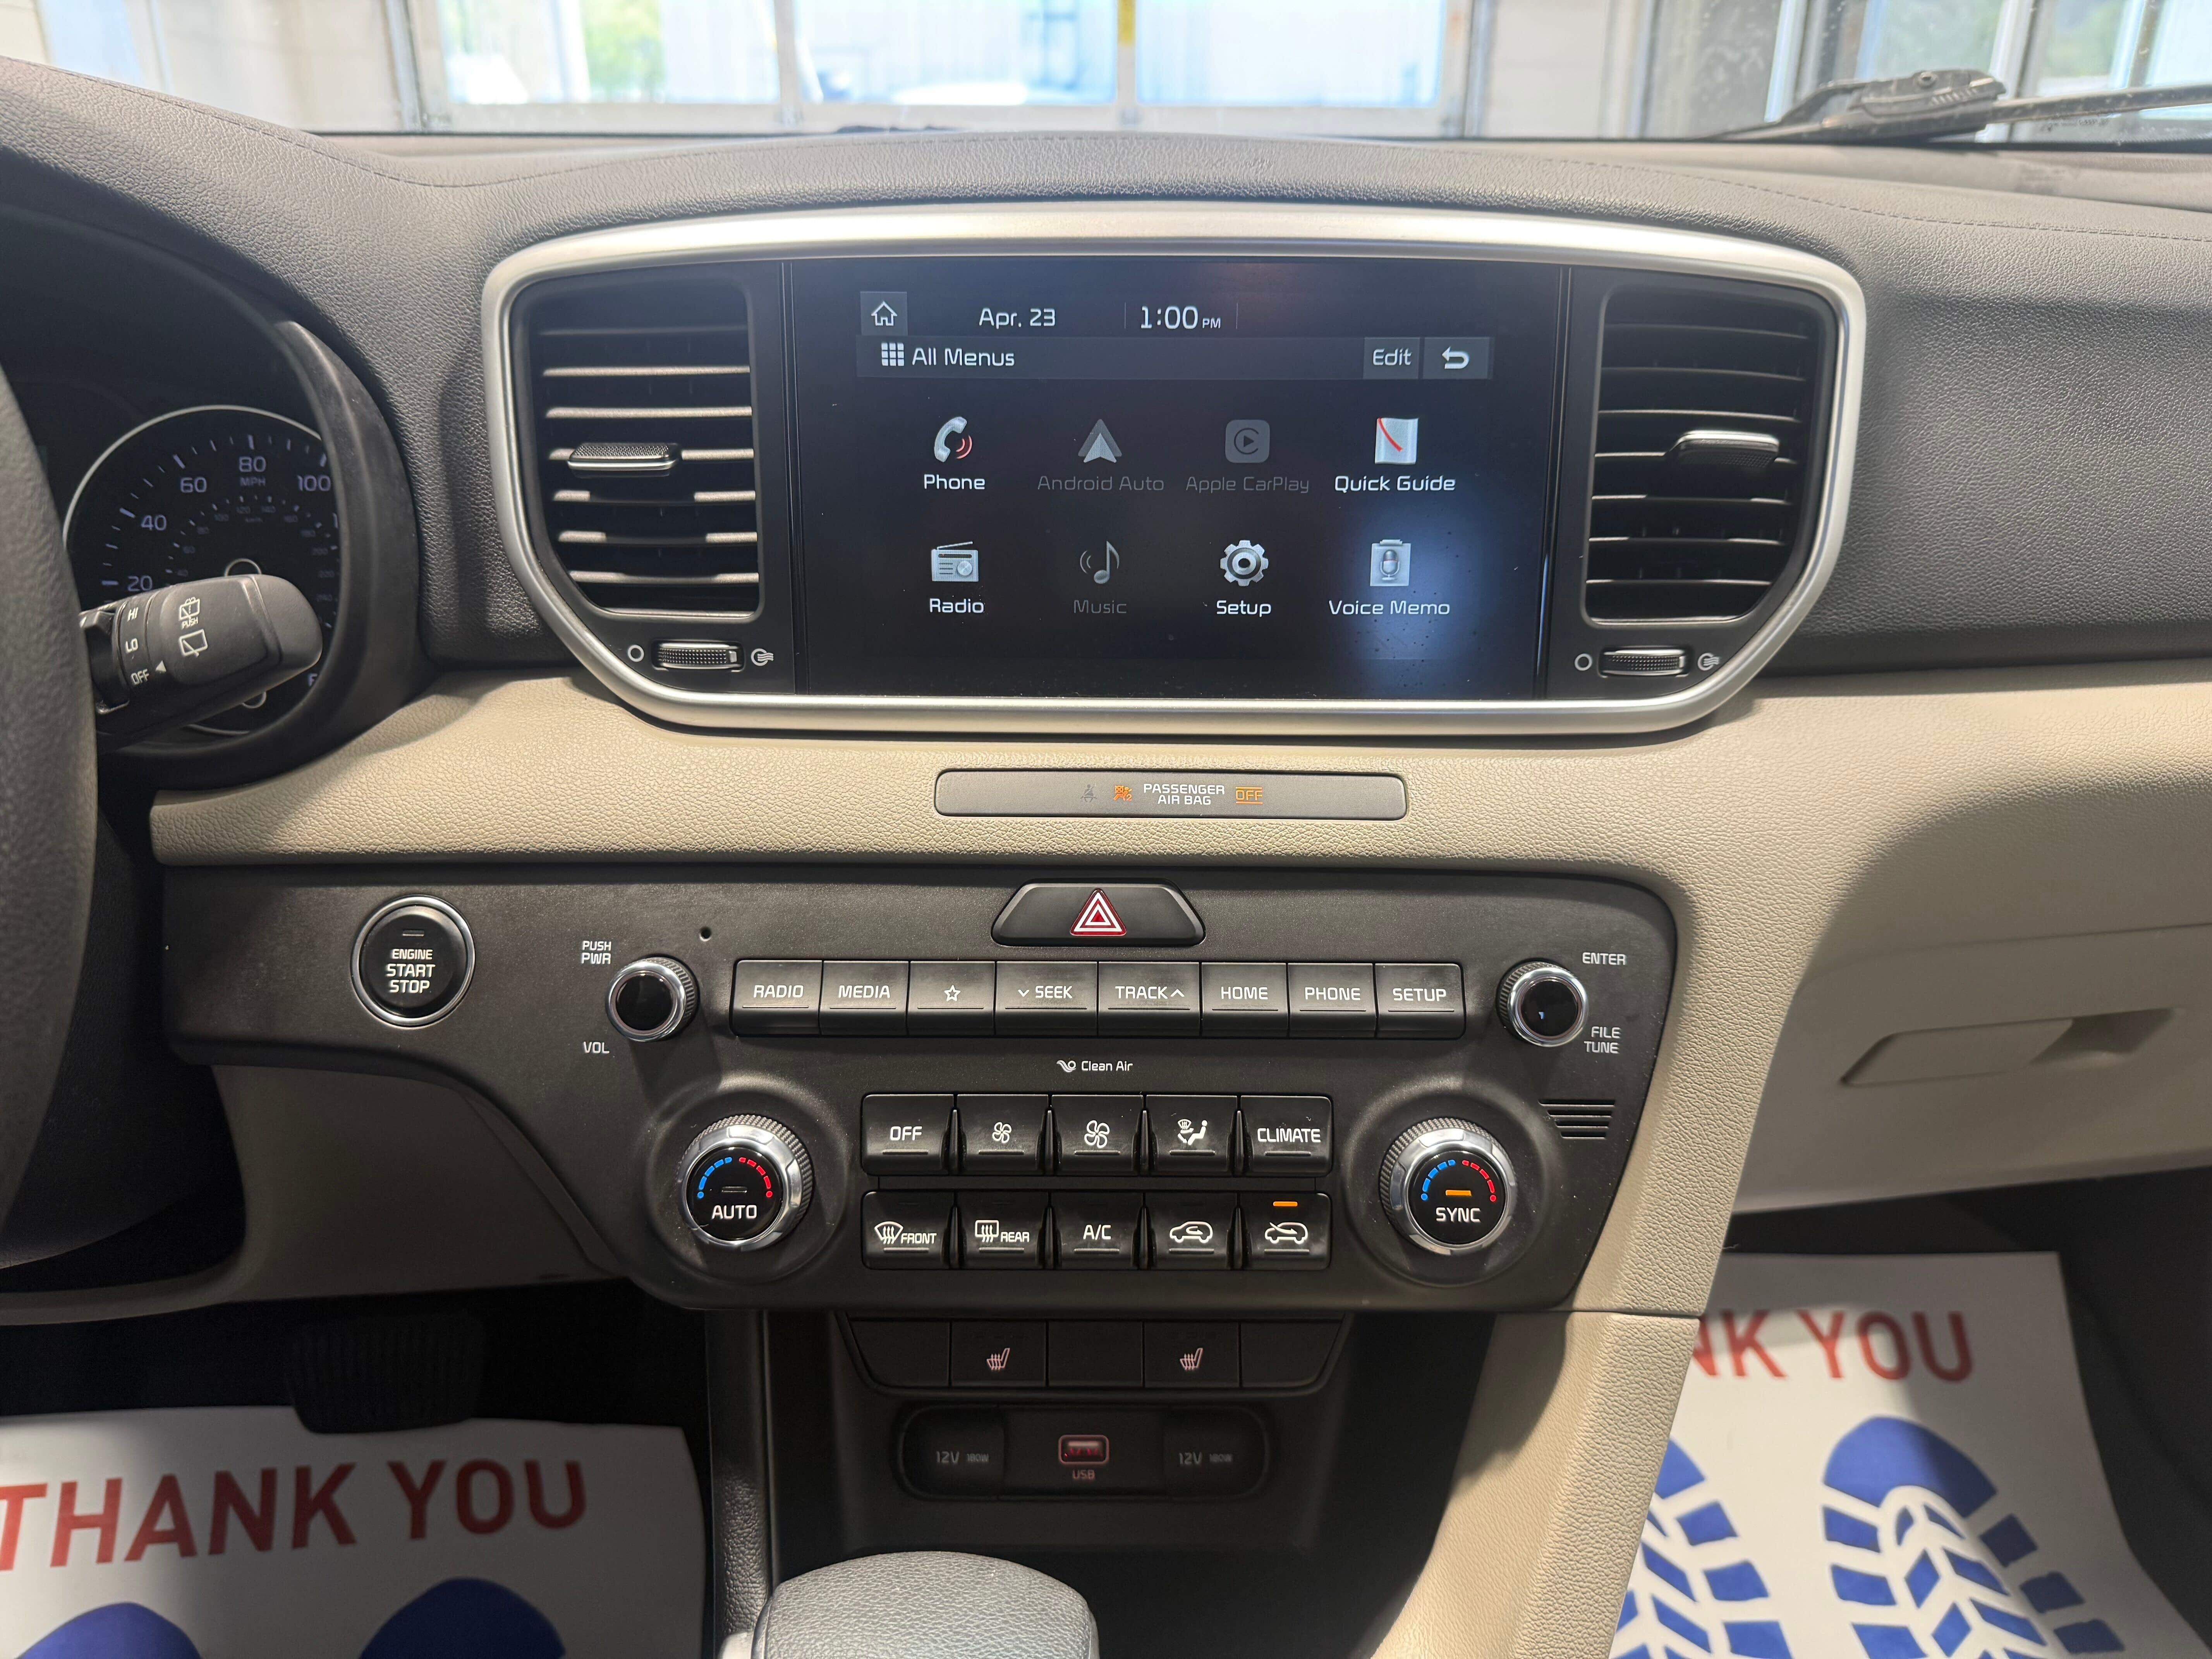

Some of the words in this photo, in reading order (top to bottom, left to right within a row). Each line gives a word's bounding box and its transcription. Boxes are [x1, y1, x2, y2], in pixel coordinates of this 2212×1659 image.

[979, 308, 1021, 329] Apr.
[1030, 309, 1055, 326] 23
[1141, 306, 1198, 329] 1:00
[1203, 318, 1221, 328] PM
[912, 348, 936, 365] All
[945, 349, 1014, 366] Menus
[1373, 349, 1411, 365] Edit
[239, 457, 266, 472] 80
[180, 477, 206, 492] 60
[240, 477, 266, 486] MPH
[298, 476, 331, 491] 100
[924, 474, 985, 489] Phone
[1038, 476, 1112, 490] Android
[1119, 476, 1164, 490] Auto
[1186, 477, 1236, 493] Apple
[1244, 477, 1309, 493] CarPlay
[1335, 476, 1390, 493] Quick
[1397, 476, 1455, 490] Guide
[141, 515, 166, 530] 40
[128, 575, 153, 592] 20
[930, 598, 984, 613] Radio
[1074, 600, 1127, 613] Music
[1217, 600, 1271, 617] Setup
[1329, 601, 1384, 614] Voice
[1391, 601, 1449, 614] Memo
[128, 607, 138, 620] HI
[182, 617, 198, 629] PUSH
[125, 638, 138, 652] LO
[131, 669, 149, 684] OFF
[1144, 783, 1225, 795] PASSENGER
[1235, 790, 1263, 801] OFF
[1158, 795, 1180, 804] AIR
[1184, 795, 1211, 805] BAG
[582, 941, 611, 951] PUSH
[392, 949, 433, 959] ENGINE
[582, 952, 611, 964] PWR
[1583, 952, 1626, 965] ENTER
[387, 964, 435, 977] START
[390, 980, 429, 993] STOP
[754, 985, 803, 998] RADIO
[838, 986, 890, 998] MEDIA
[1036, 986, 1072, 998] SEEK
[1115, 986, 1168, 999] TRACK
[1221, 987, 1268, 1000] HOME
[1305, 988, 1360, 1000] PHONE
[1393, 988, 1446, 1001] SETUP
[1592, 1027, 1620, 1038] FILE
[584, 1042, 609, 1053] VOL
[1584, 1041, 1618, 1053] TUNE
[1082, 1061, 1112, 1071] Clean
[1116, 1061, 1133, 1071] Air
[890, 1127, 922, 1140] OFF
[1257, 1128, 1321, 1142] CLIMATE
[712, 1205, 757, 1219] AUTO
[1436, 1207, 1480, 1222] SYNC
[901, 1233, 937, 1244] FRONT
[1001, 1231, 1030, 1242] REAR
[1083, 1225, 1111, 1240] A/C
[1796, 1309, 1973, 1382] YOU
[937, 1451, 959, 1464] 12V
[1179, 1453, 1202, 1465] 12V
[1073, 1470, 1094, 1480] USB
[0, 1463, 358, 1572] THANK
[389, 1460, 585, 1540] YOU
